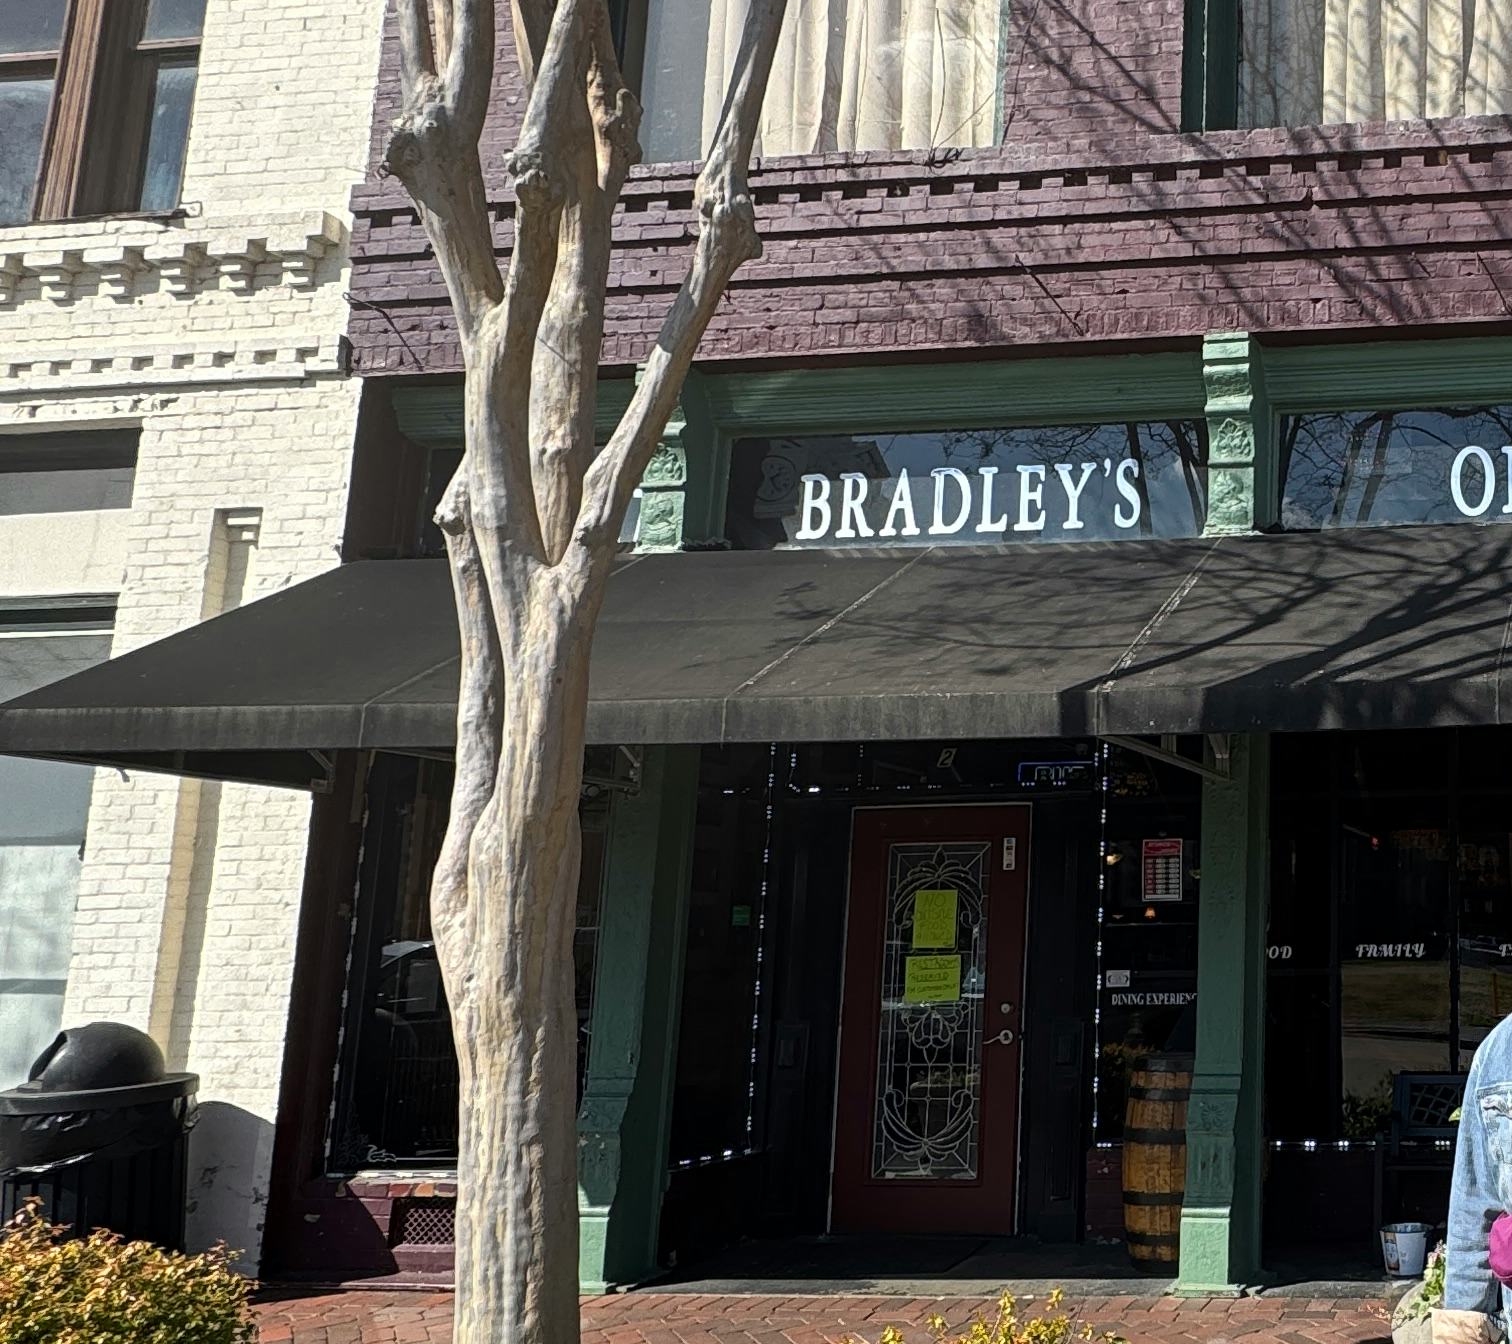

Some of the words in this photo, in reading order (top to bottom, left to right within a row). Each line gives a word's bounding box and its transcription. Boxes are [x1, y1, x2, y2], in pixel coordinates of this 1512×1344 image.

[795, 457, 1142, 541] BRADLEY'S
[1265, 945, 1293, 960] OD
[1355, 942, 1427, 959] FAMILY
[1111, 992, 1145, 1006] DINING
[1145, 992, 1198, 1006] EXPERIEN
